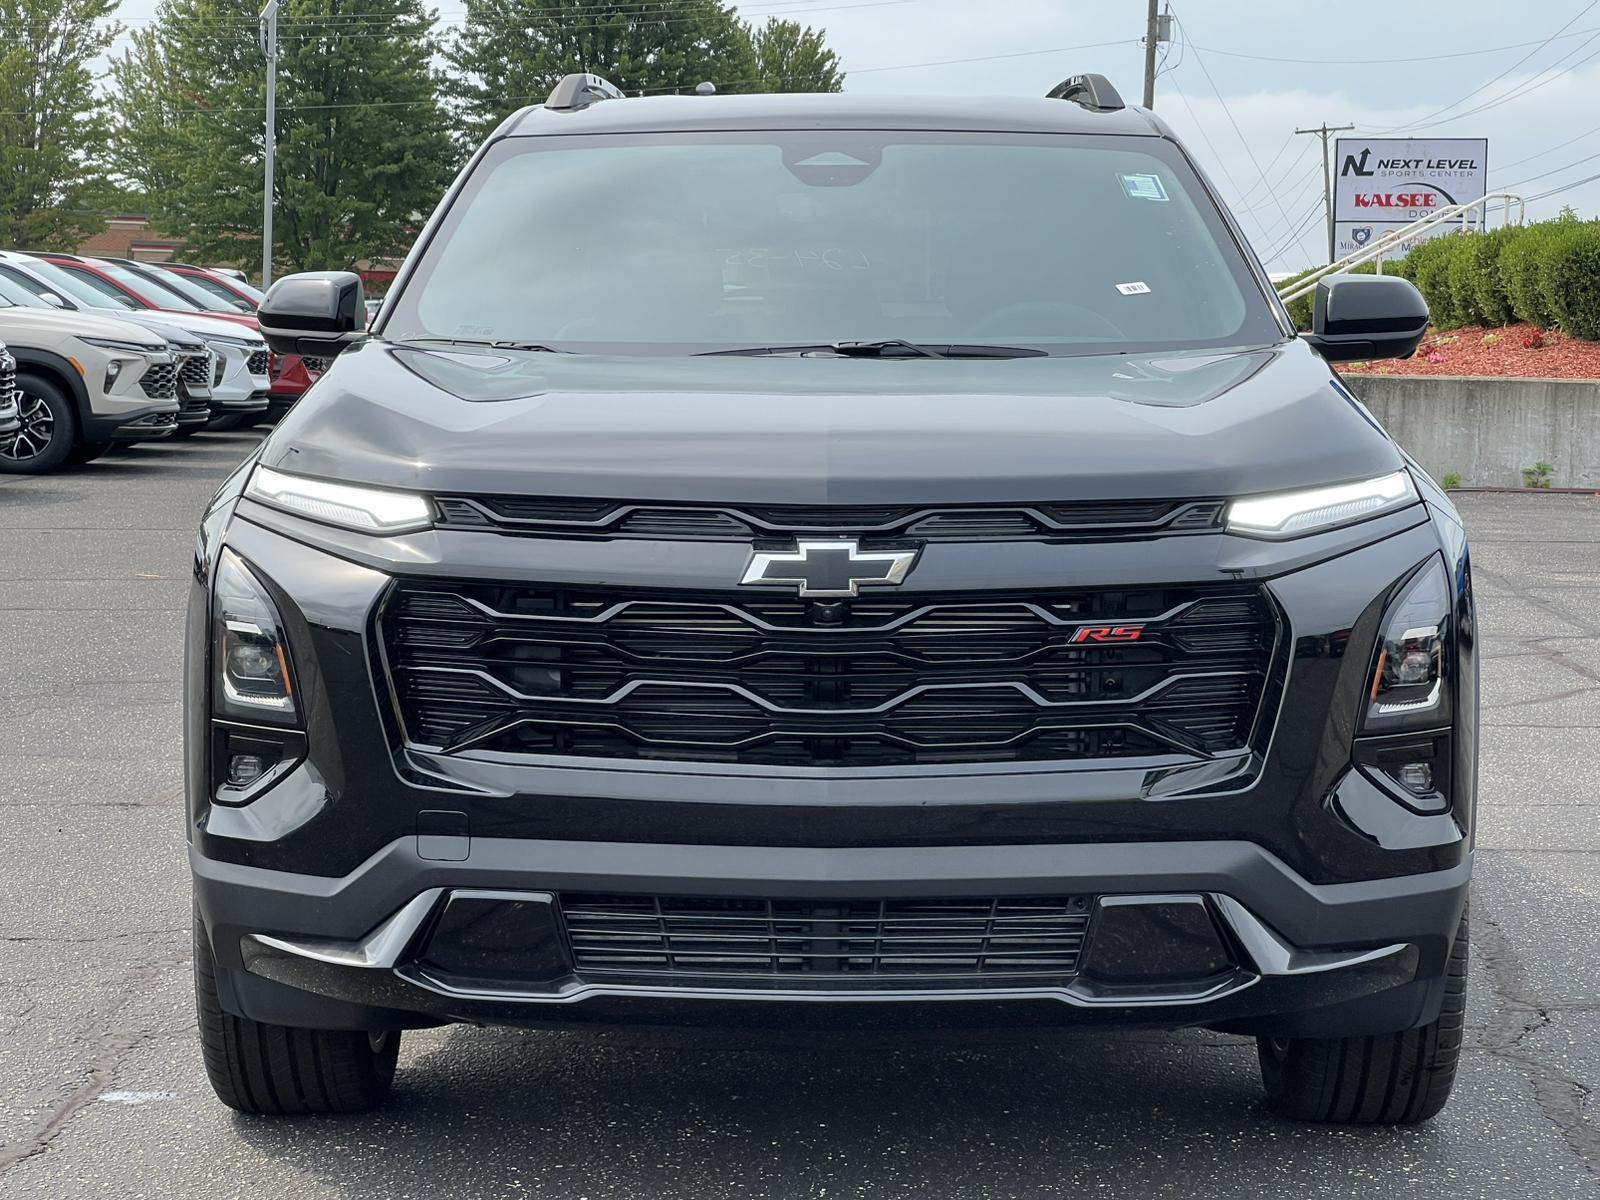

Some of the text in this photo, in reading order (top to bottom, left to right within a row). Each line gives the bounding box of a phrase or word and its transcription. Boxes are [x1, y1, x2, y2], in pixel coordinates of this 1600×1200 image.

[1377, 159, 1477, 169] NEXT LEVEL
[1354, 193, 1437, 207] KALSEE
[1074, 626, 1145, 642] RS
